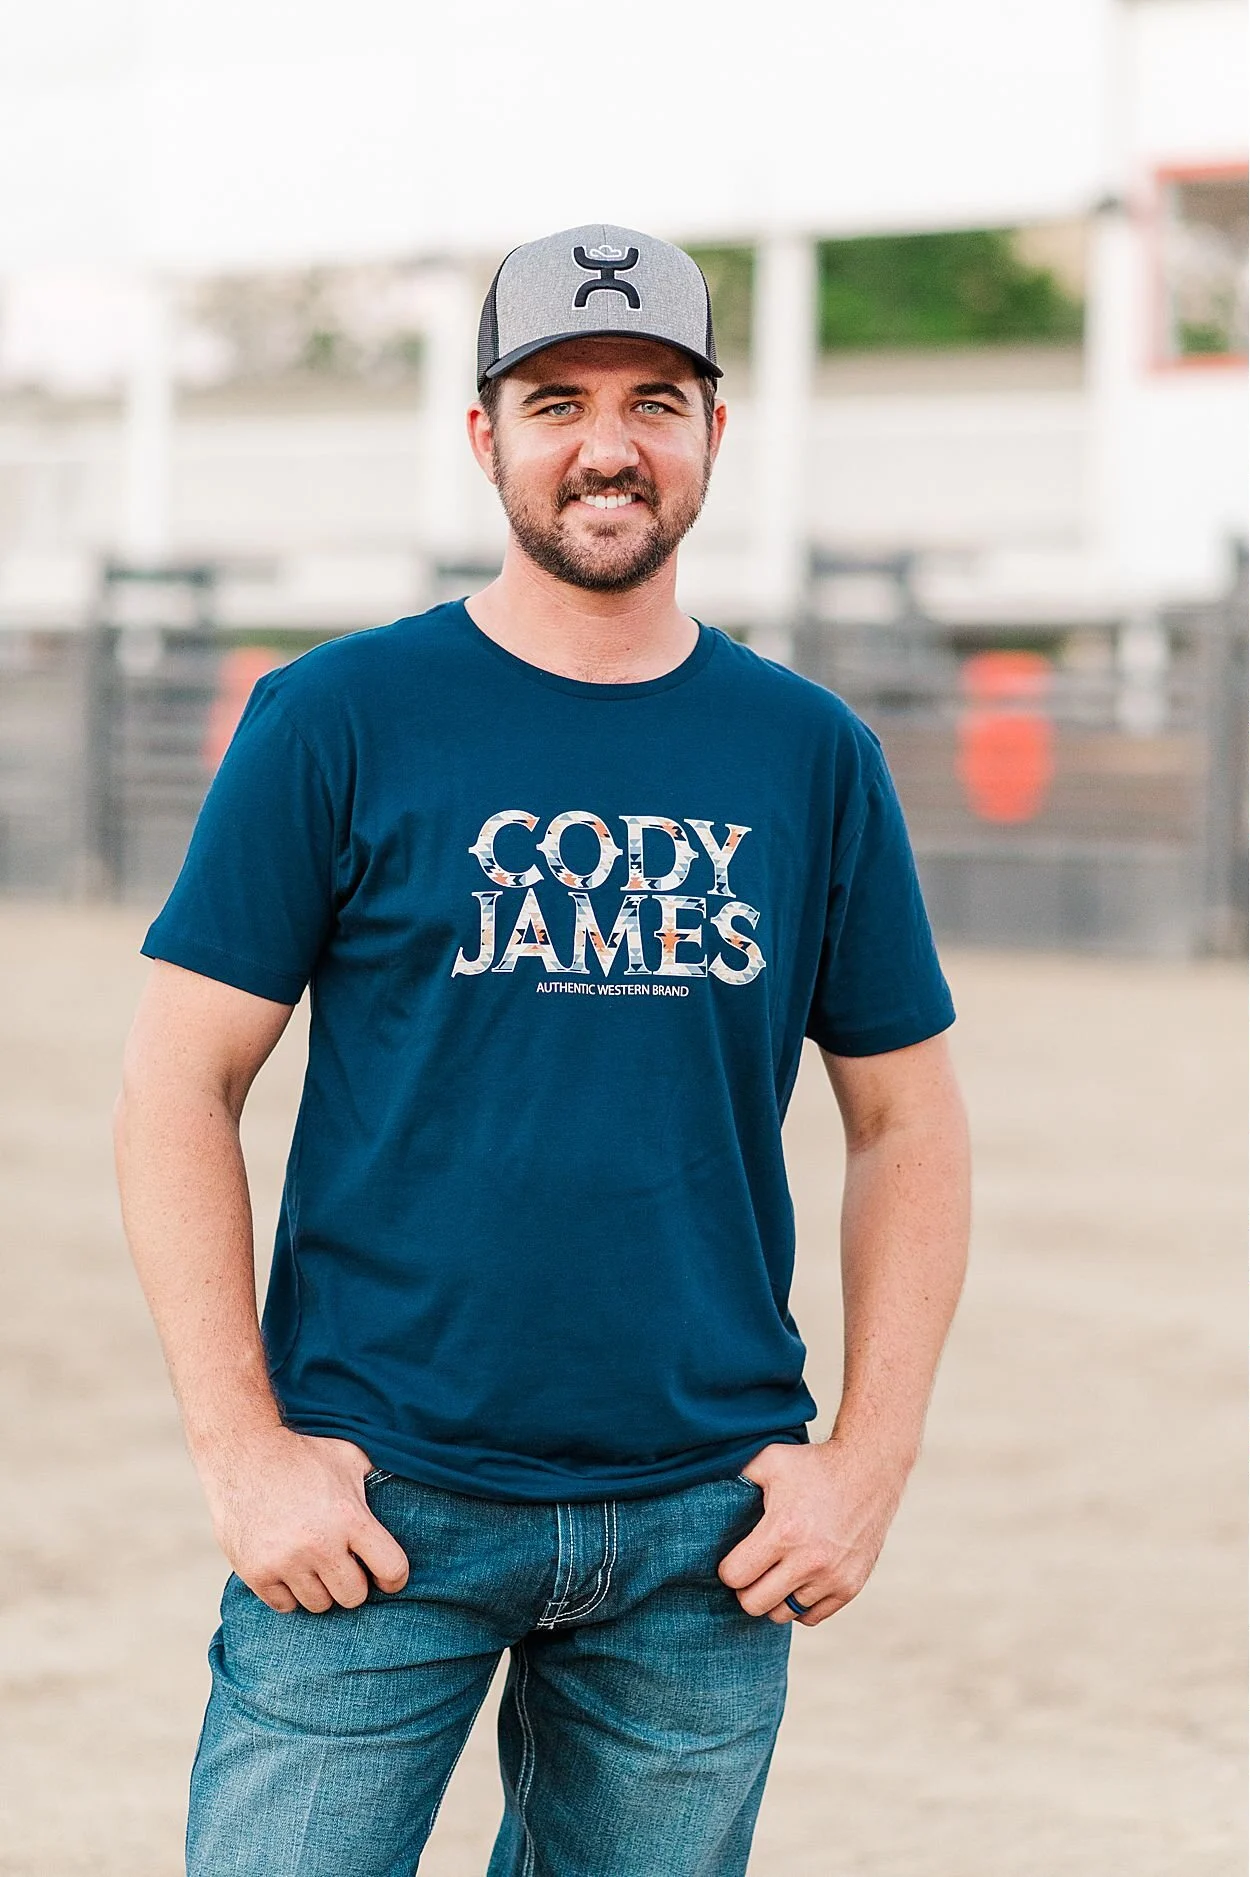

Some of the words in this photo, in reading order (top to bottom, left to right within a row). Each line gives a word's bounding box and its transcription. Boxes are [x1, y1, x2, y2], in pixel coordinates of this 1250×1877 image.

[468, 809, 752, 898] CODY
[451, 887, 767, 986] JAMES
[536, 982, 596, 995] AUTHENTIC
[597, 984, 650, 996] WESTERN
[652, 984, 689, 997] BRAND
